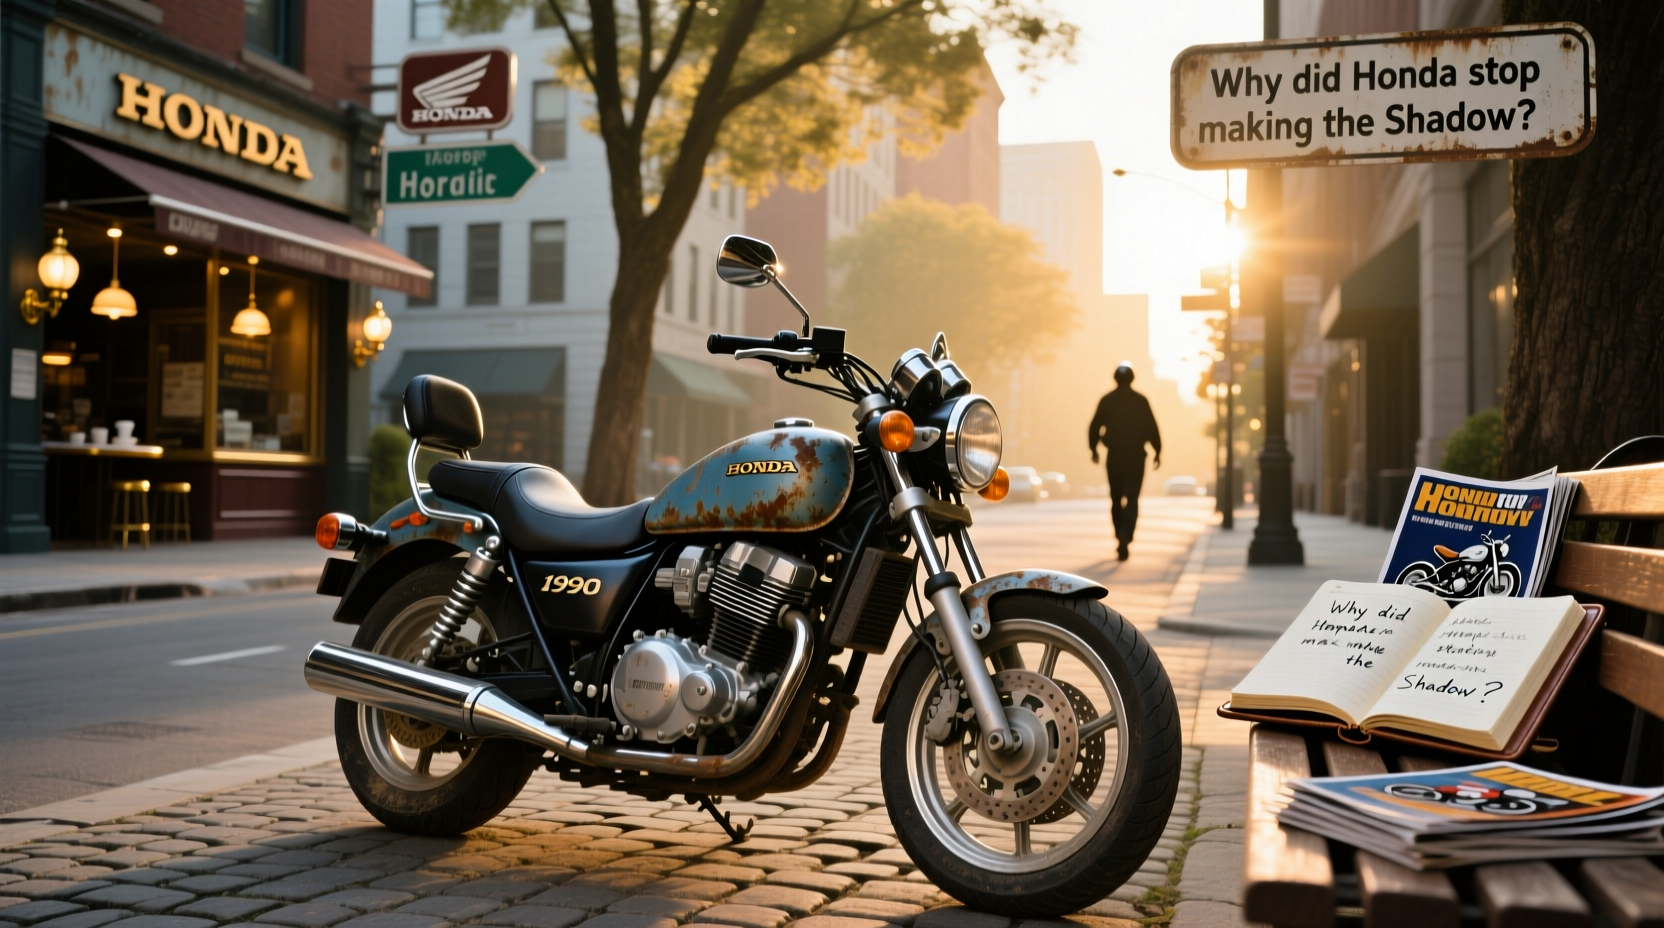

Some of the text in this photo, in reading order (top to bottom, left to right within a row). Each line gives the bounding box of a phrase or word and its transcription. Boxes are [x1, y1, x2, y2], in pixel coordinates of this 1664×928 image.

[1210, 57, 1540, 104] Why did Honda stop
[411, 105, 494, 123] HONDA
[1198, 98, 1537, 148] making the Shadow?
[116, 72, 314, 180] HONDA
[726, 460, 799, 477] HONDA
[540, 574, 602, 596] 1990
[1330, 600, 1412, 622] Why did
[1346, 654, 1374, 668] the
